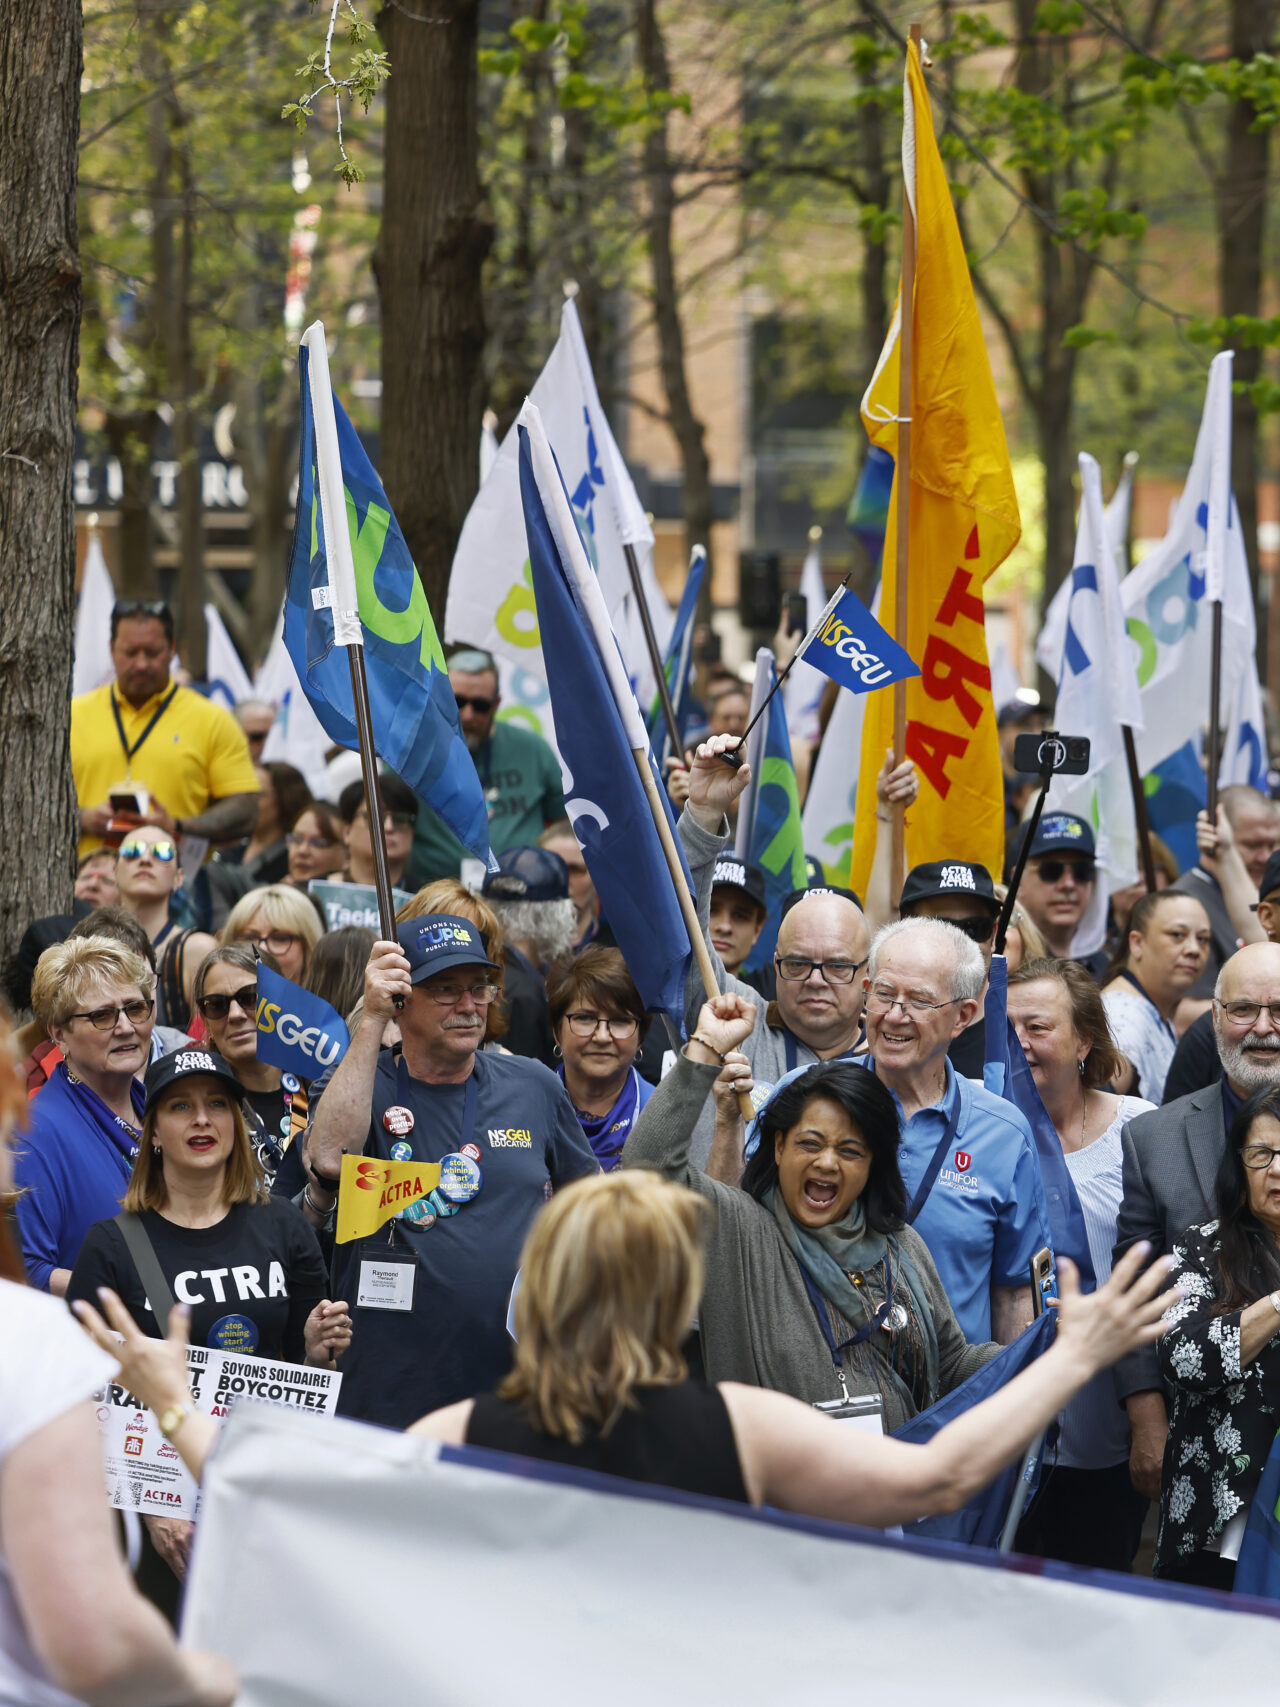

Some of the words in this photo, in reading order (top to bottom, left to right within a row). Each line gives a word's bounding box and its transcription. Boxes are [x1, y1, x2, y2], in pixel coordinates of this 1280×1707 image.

[817, 613, 893, 684] NSGEU
[941, 866, 972, 876] ACTRA
[940, 880, 976, 890] ACTION
[326, 902, 381, 927] Tack
[175, 1052, 212, 1062] ACTRA
[175, 1062, 216, 1074] ACTION
[488, 1129, 531, 1141] NSGEU
[490, 1140, 531, 1149] EDUCATION
[443, 1167, 473, 1175] whining
[378, 1177, 424, 1209] ACTRA
[439, 1183, 479, 1192] organizing
[373, 1270, 399, 1278] Raymond
[144, 1261, 288, 1311] CTRA
[218, 1330, 249, 1338] whining
[221, 1361, 267, 1379] SOYONS
[269, 1367, 331, 1388] SOLIDAIRE!
[218, 1375, 328, 1409] BOYCOTTEZ
[156, 1449, 179, 1460] Country
[144, 1490, 182, 1503] ACTRA
